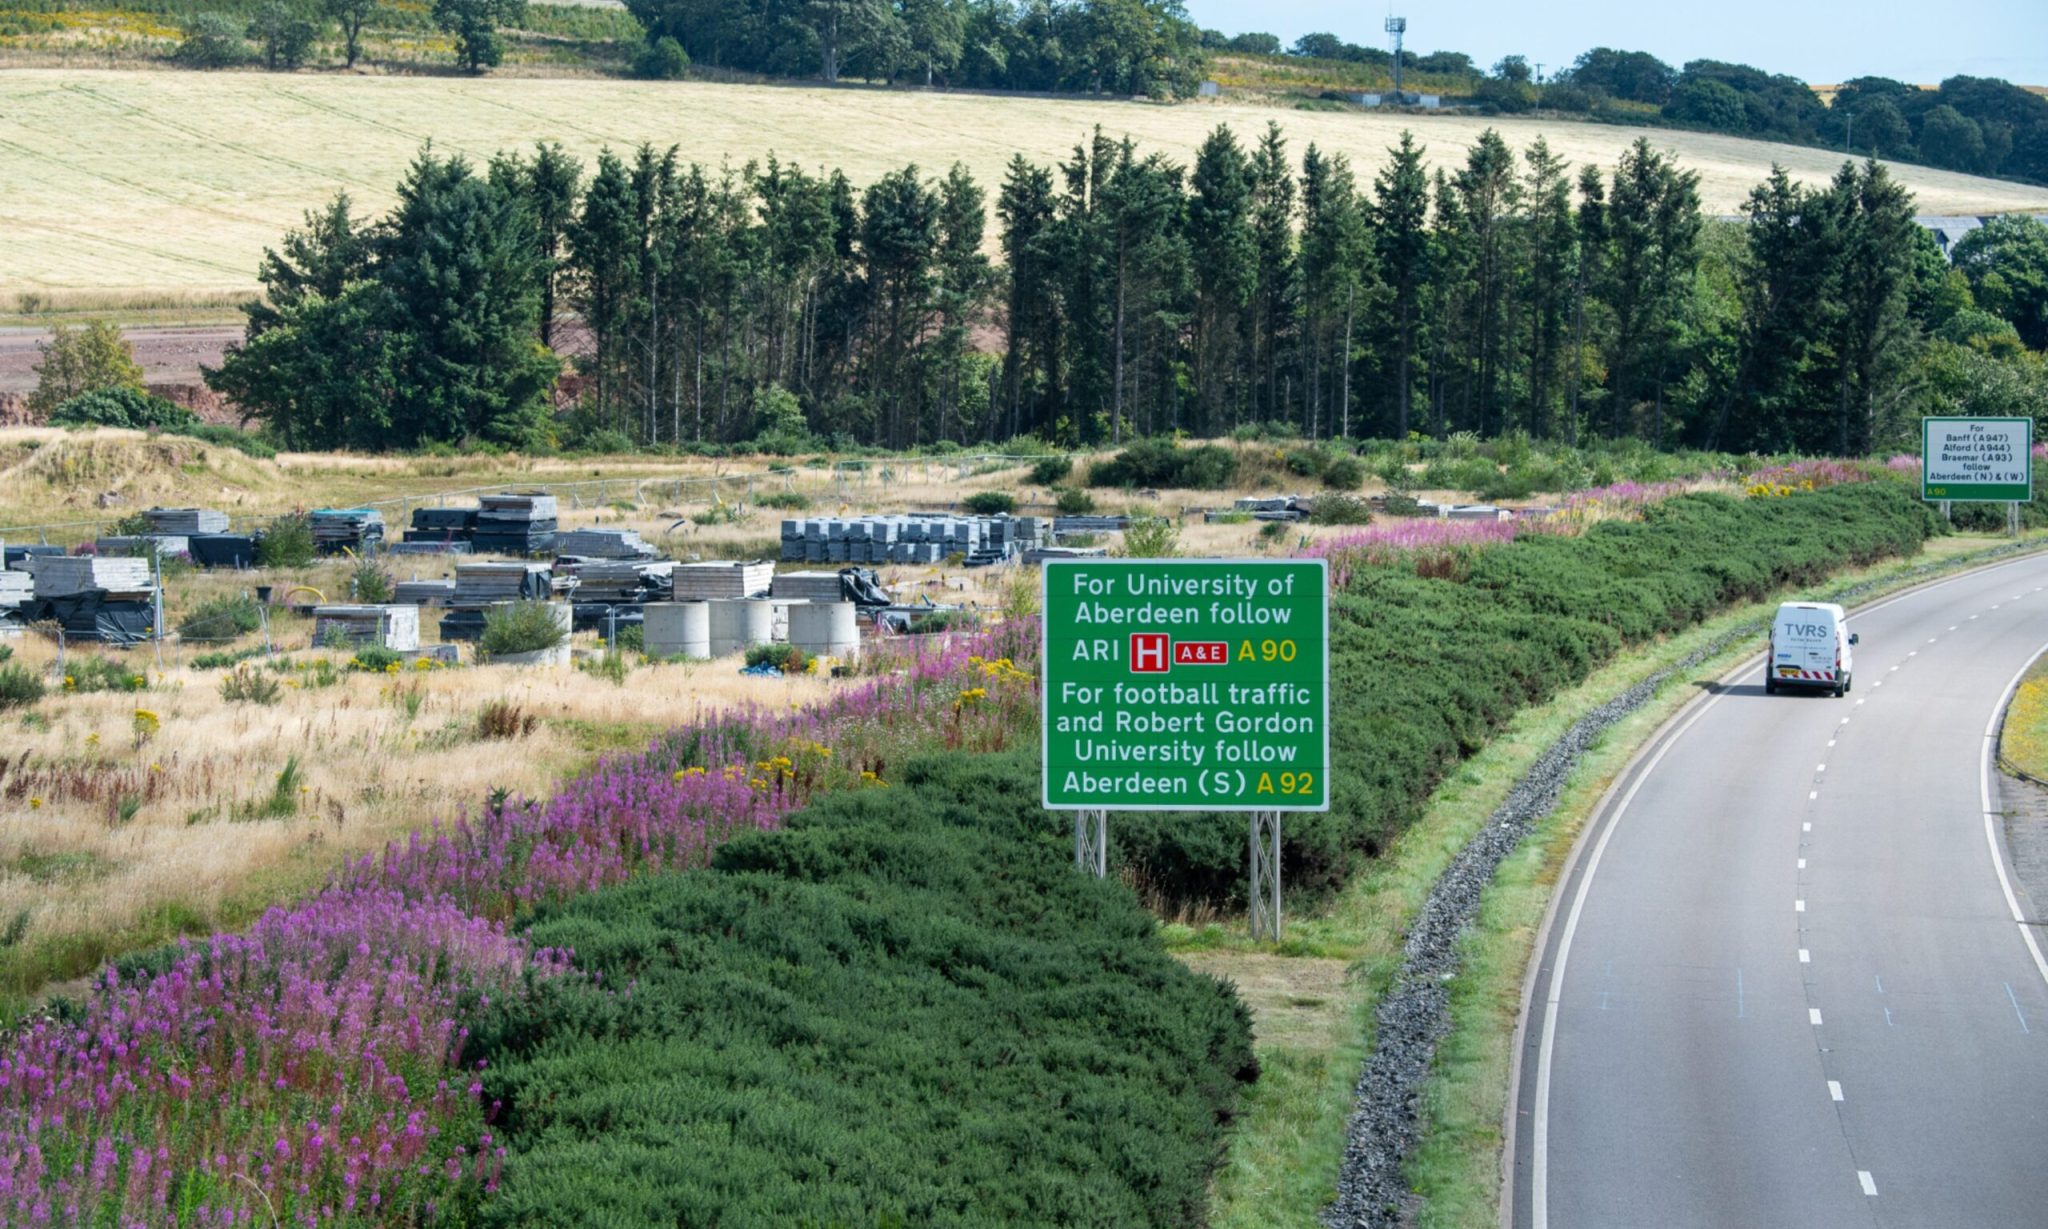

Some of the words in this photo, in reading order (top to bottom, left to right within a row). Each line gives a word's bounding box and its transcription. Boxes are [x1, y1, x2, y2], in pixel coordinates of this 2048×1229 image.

[1973, 434, 2008, 442] (A947)
[1982, 454, 2012, 462] (A93)
[1974, 472, 1993, 481] (N)
[2004, 473, 2024, 481] (W)
[1073, 573, 1115, 596] For
[1127, 574, 1257, 599] University
[1268, 574, 1294, 596] of
[1075, 602, 1199, 624] Aberdeen
[1210, 603, 1292, 624] follow
[1785, 624, 1827, 637] TVRS
[1072, 640, 1119, 661] ARI
[1238, 640, 1297, 662] A90
[1062, 682, 1103, 704] For
[1114, 682, 1219, 704] football
[1229, 683, 1310, 705] traffic
[1056, 711, 1103, 732] and
[1116, 711, 1204, 733] Robert
[1215, 711, 1313, 733] Gordon
[1075, 740, 1205, 766] University
[1216, 740, 1297, 762] follow
[1063, 771, 1187, 793] Aberdeen
[1198, 769, 1246, 796] (S)
[1257, 772, 1313, 795] A92
